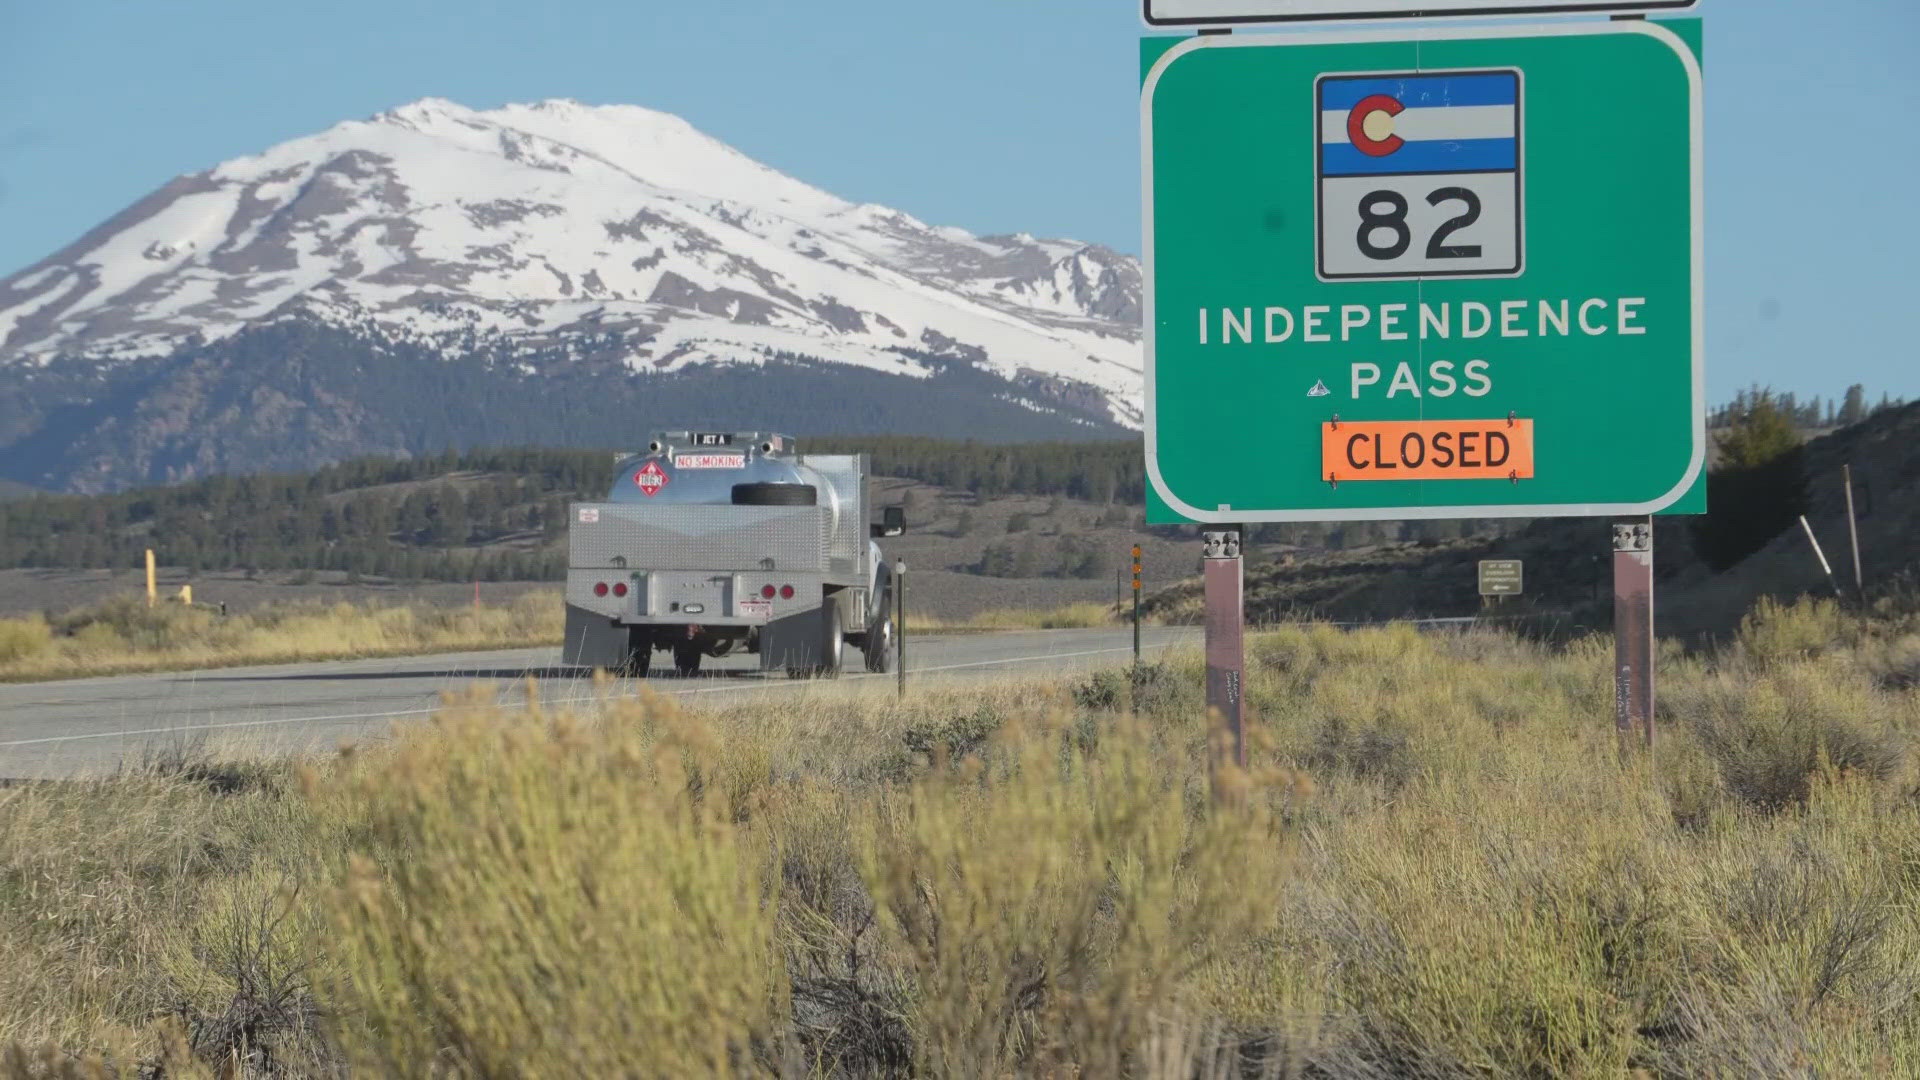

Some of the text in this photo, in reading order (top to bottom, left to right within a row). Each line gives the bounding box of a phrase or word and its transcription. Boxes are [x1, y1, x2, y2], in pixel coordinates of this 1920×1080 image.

[1356, 186, 1482, 260] 82
[1199, 297, 1647, 345] INDEPENDENCE
[1351, 360, 1493, 399] PASS
[702, 435, 725, 445] JET A
[1346, 431, 1510, 470] CLOSED
[677, 456, 744, 467] NO SMOKING
